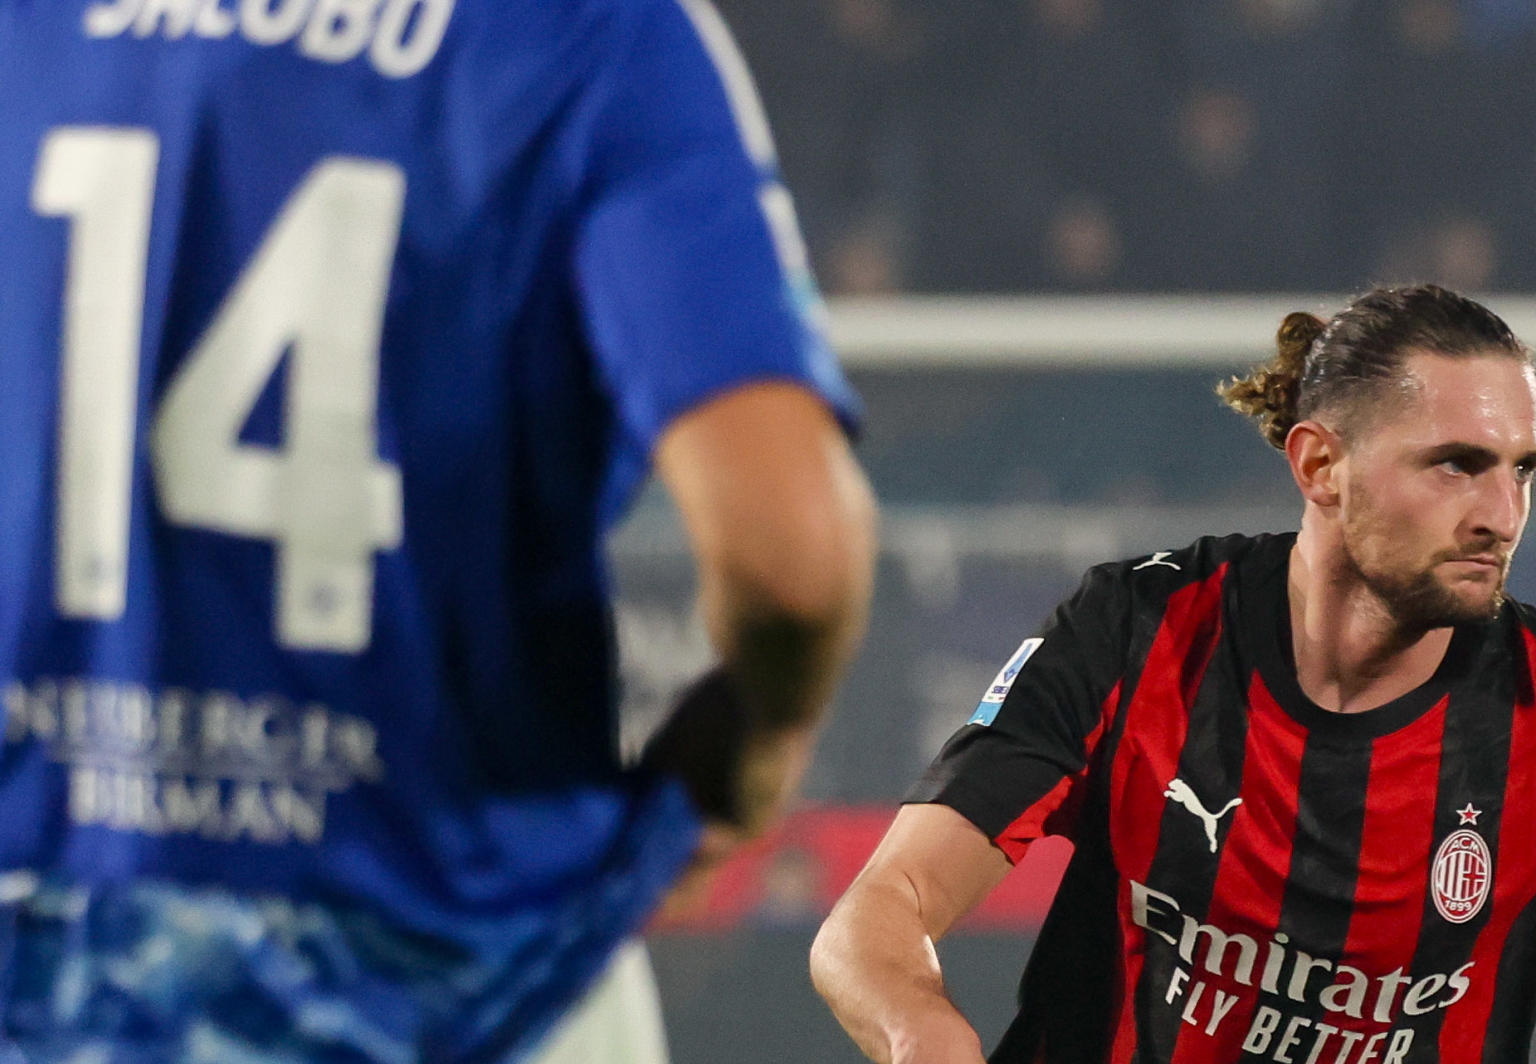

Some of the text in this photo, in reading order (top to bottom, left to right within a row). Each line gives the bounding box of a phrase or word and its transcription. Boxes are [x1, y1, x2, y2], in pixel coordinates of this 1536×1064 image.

[32, 125, 407, 656] 14
[1447, 837, 1481, 856] ACM
[1444, 900, 1473, 912] 1899
[1129, 879, 1476, 1024] Emirates
[1165, 966, 1240, 1037] FLY
